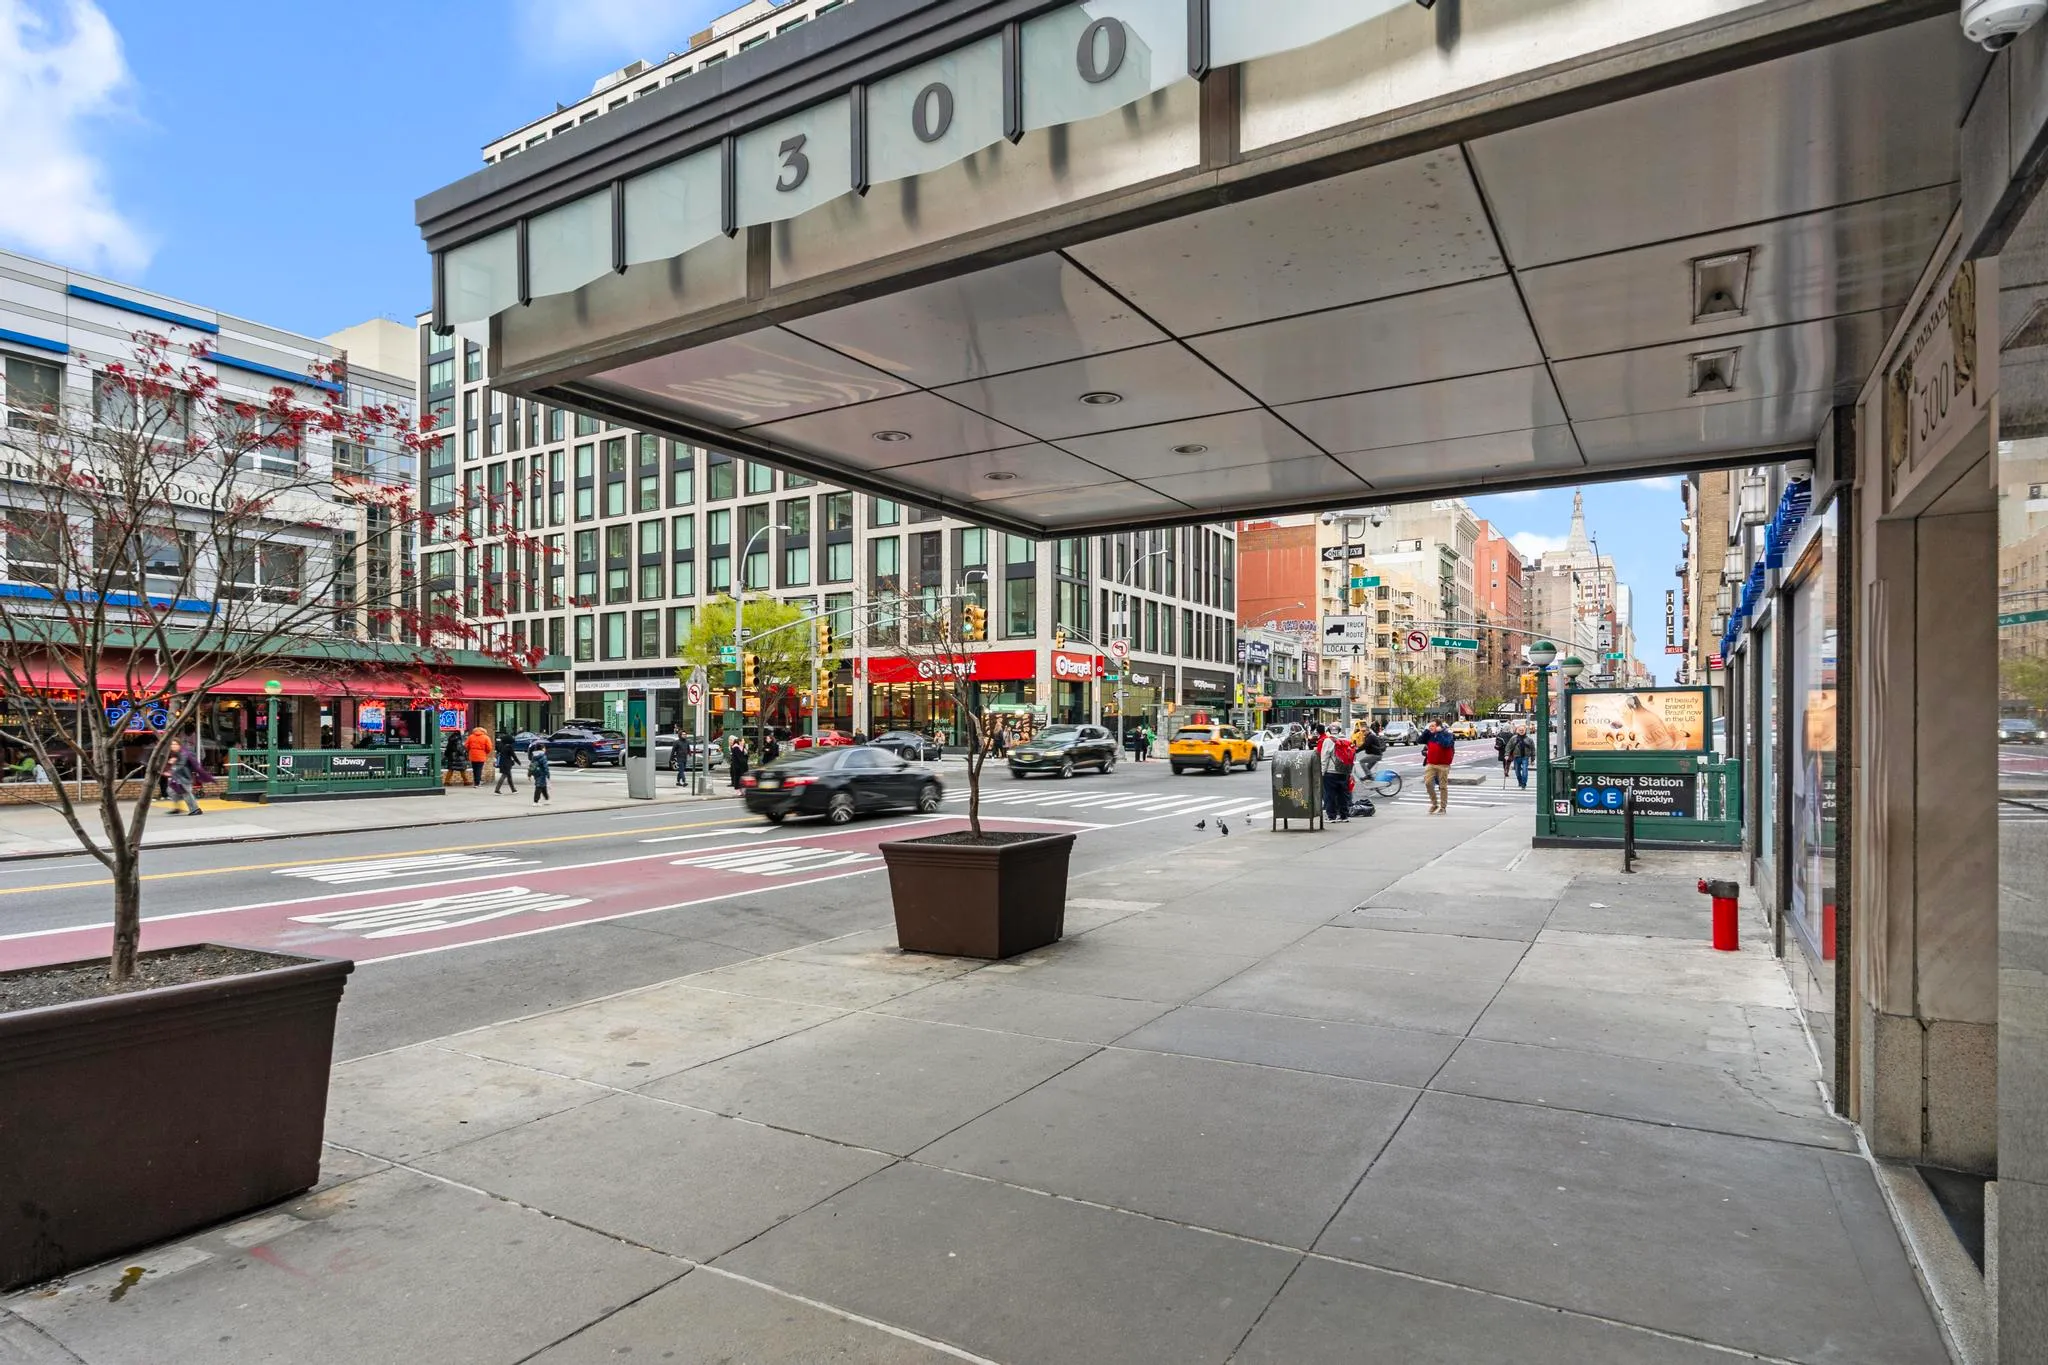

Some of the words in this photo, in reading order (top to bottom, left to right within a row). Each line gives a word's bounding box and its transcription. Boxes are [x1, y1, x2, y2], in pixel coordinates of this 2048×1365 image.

[1920, 360, 1949, 442] 300
[80, 468, 150, 496] Sini
[166, 482, 244, 511] Docto
[1358, 578, 1364, 587] 8
[1346, 621, 1364, 629] TRUCK
[1666, 593, 1674, 646] HOTEL
[1326, 645, 1348, 653] LOCAL
[1066, 659, 1091, 678] target
[1574, 717, 1611, 725] natura
[332, 756, 366, 767] Subway
[1577, 776, 1593, 786] 23
[1597, 776, 1634, 787] Street
[1639, 776, 1684, 787] Station
[1632, 788, 1671, 796] owntown
[1583, 792, 1594, 803] C
[1606, 792, 1617, 804] E
[1635, 795, 1674, 804] Brooklyn
